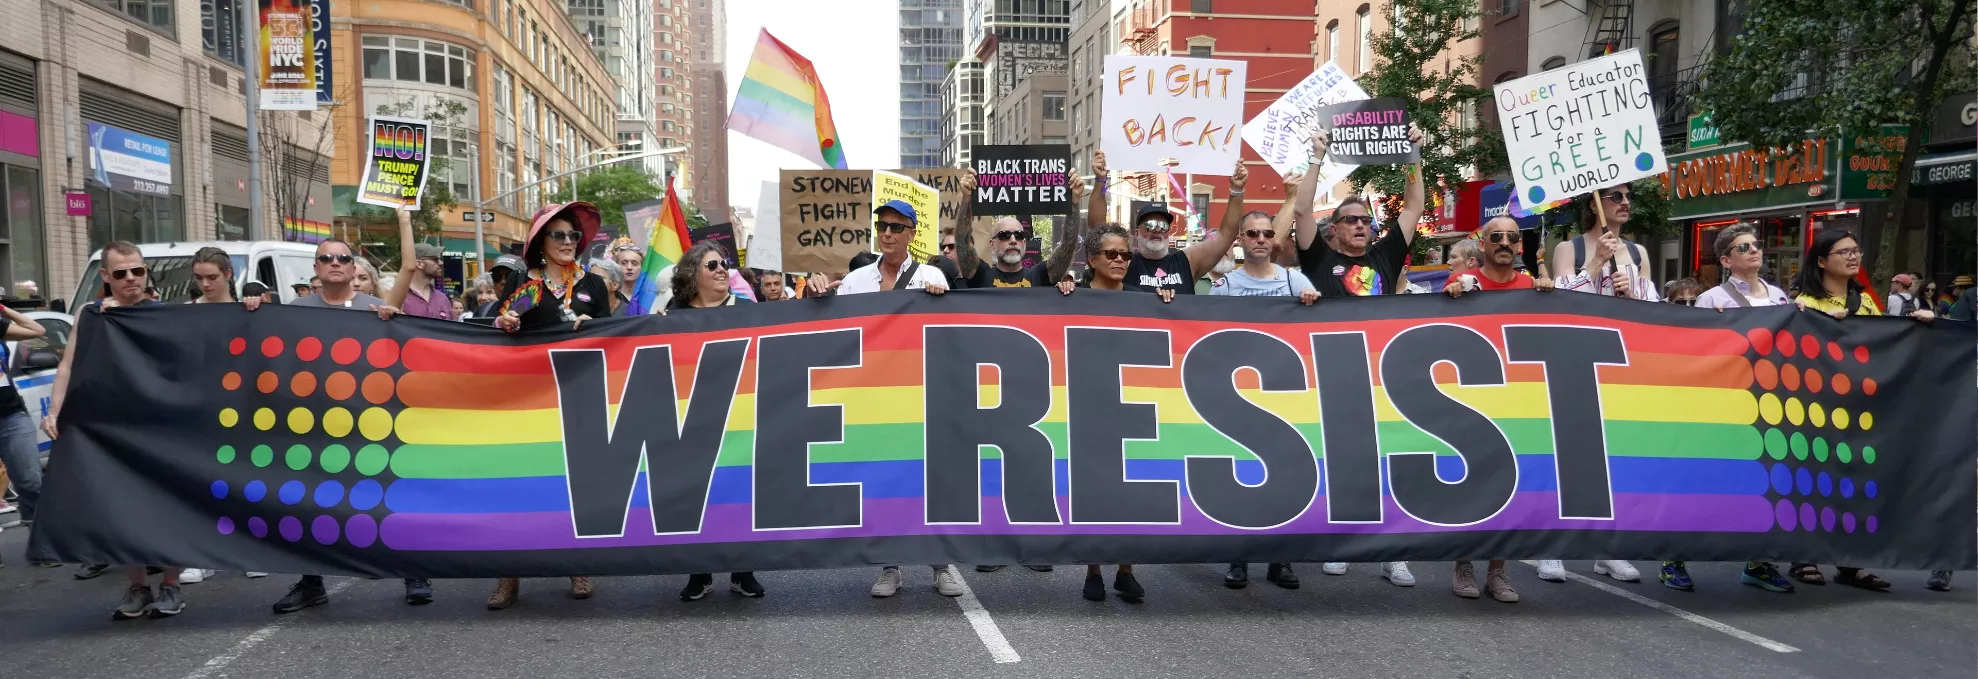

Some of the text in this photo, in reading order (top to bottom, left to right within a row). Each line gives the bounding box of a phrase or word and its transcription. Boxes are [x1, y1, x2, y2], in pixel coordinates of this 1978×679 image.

[270, 45, 303, 54] PRIDE
[270, 54, 304, 67] NYC
[1118, 64, 1233, 100] FIGHT
[1500, 61, 1642, 112] Queer Educator
[1283, 97, 1328, 135] TRANS
[1332, 109, 1404, 127] DISABILITY
[1511, 78, 1652, 142] FIGHTING
[374, 123, 425, 161] NO!
[1122, 113, 1236, 153] BACK!
[1331, 125, 1407, 142] RIGHTS ARE
[1555, 126, 1603, 149] for a
[124, 138, 142, 151] RETAIL
[141, 141, 152, 154] FOR
[1330, 140, 1412, 156] CIVIL RIGHTS
[1521, 124, 1643, 182] GREEN
[378, 160, 419, 175] TRUMP/
[978, 158, 1066, 175] BLACK TRANS
[1676, 148, 1768, 199] GOURMET
[1928, 163, 1972, 182] GEORGE
[366, 181, 419, 197] MUST GO!
[377, 172, 414, 186] PENCE
[791, 176, 873, 195] STONEW
[885, 178, 929, 199] End the
[978, 173, 1065, 187] WOMEN'S LIVES
[1560, 163, 1620, 194] WORLD
[882, 187, 927, 208] Murder
[977, 186, 1067, 203] MATTER
[798, 202, 862, 223] FIGHT
[797, 226, 836, 247] GAY
[548, 323, 1630, 539] WE RESIST
